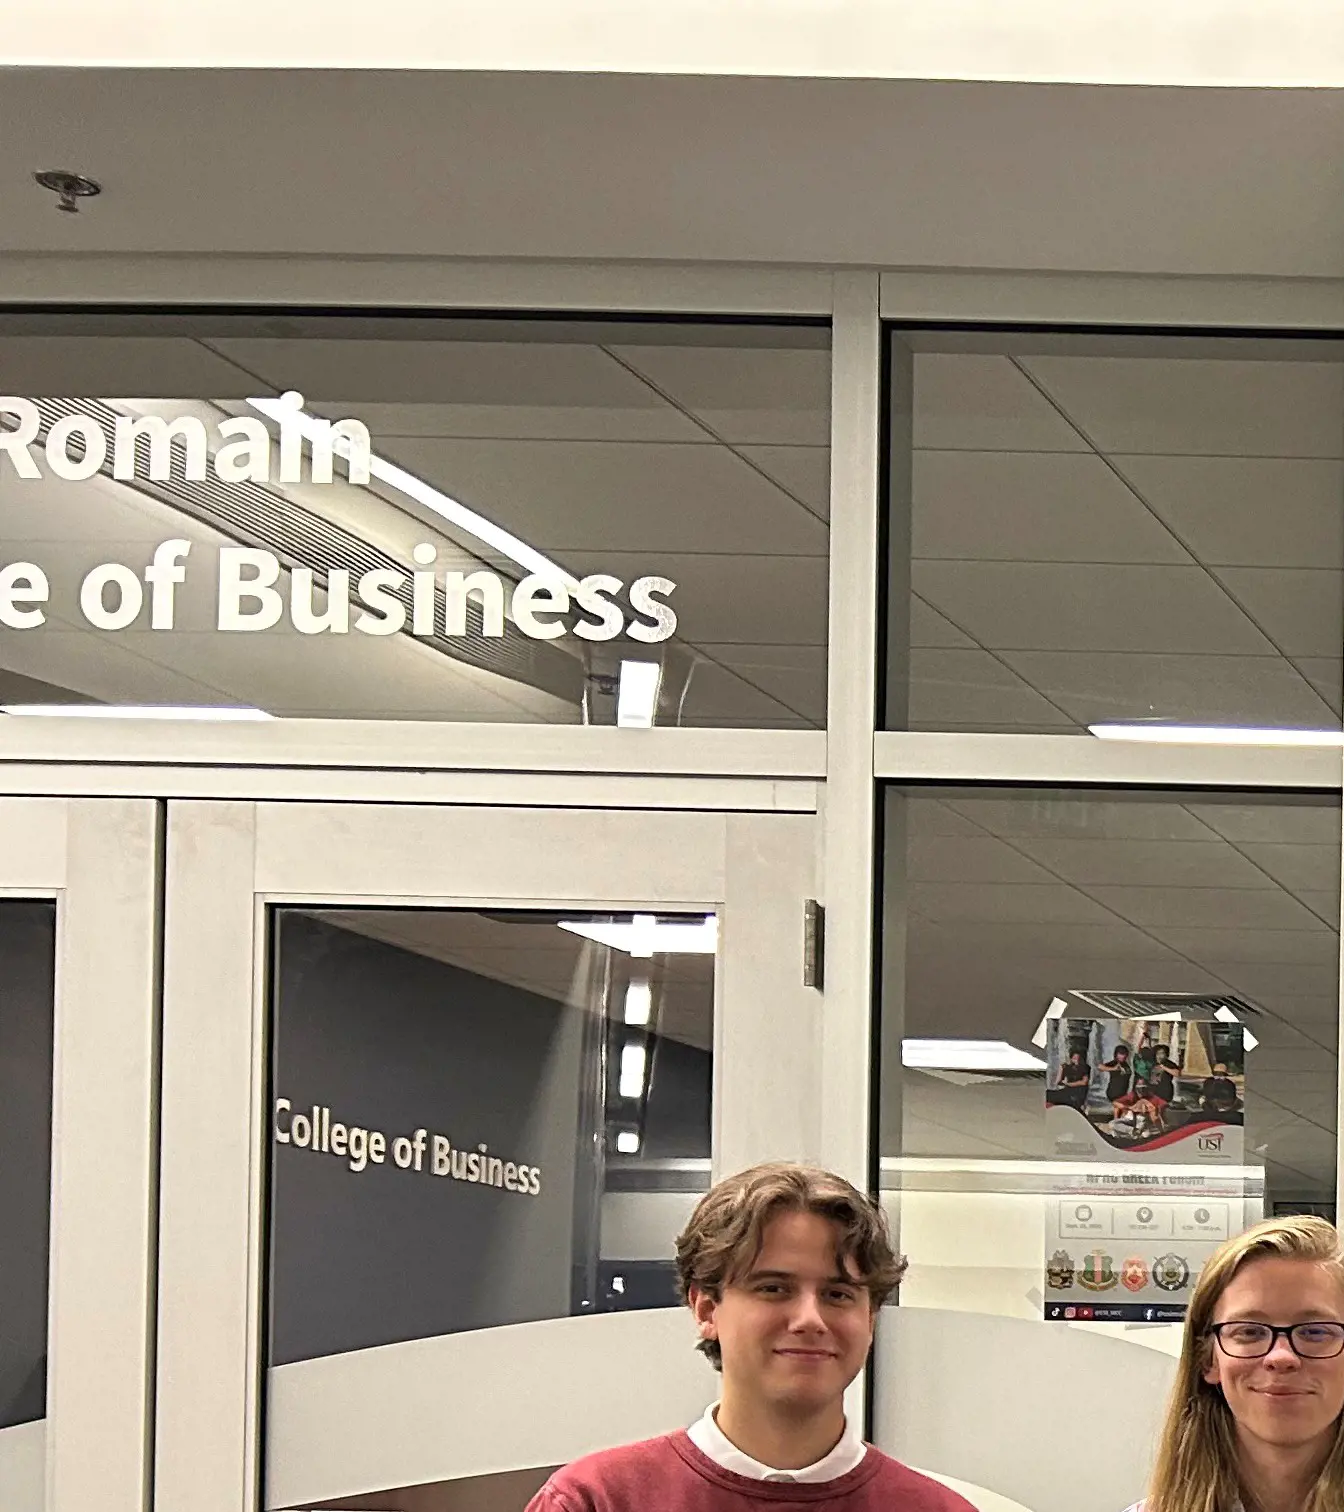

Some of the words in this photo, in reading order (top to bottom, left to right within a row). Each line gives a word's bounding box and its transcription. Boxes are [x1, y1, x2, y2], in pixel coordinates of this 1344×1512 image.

[0, 390, 372, 485] Romain
[80, 538, 192, 630] of
[216, 542, 679, 644] Business
[275, 1098, 386, 1173] College
[392, 1128, 428, 1172] of
[430, 1133, 541, 1196] Business
[1198, 1136, 1222, 1151] USI
